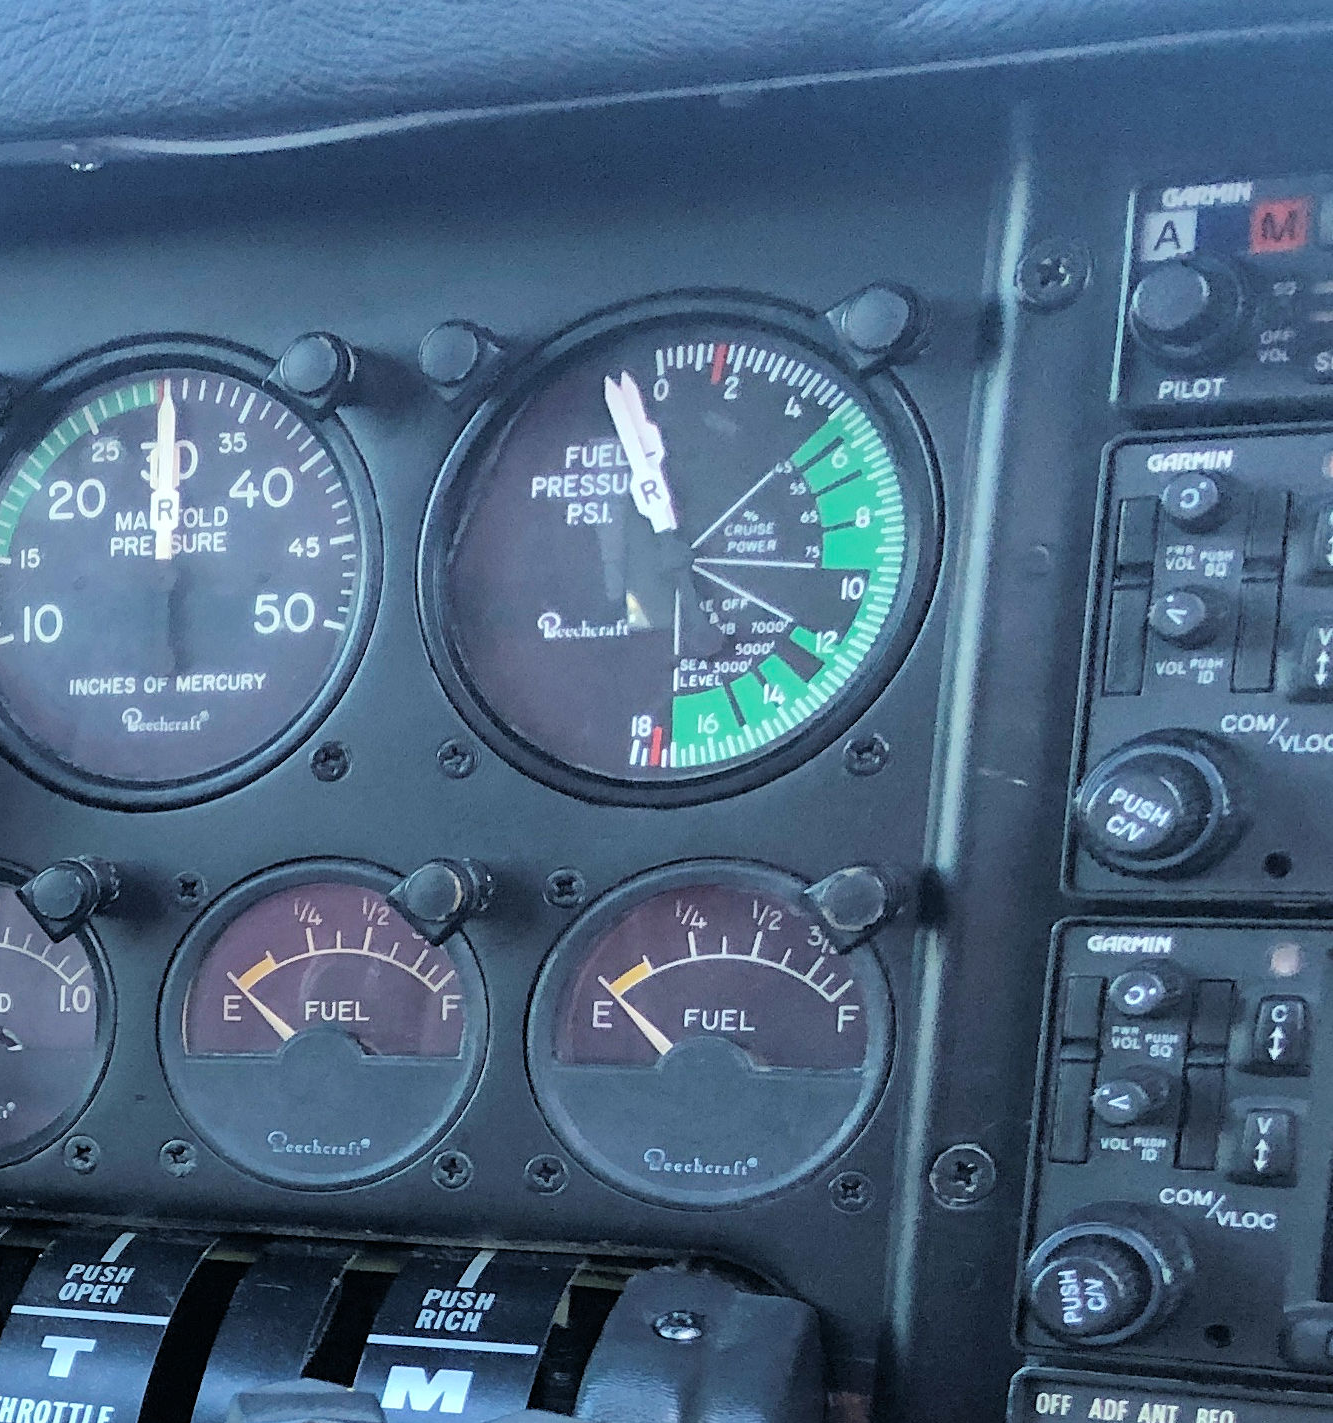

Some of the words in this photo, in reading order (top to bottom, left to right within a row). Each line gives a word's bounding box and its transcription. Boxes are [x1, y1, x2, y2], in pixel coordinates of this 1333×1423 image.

[1162, 181, 1253, 208] GARMIN
[1158, 377, 1226, 399] PILOT
[92, 444, 120, 461] 25
[219, 434, 247, 453] 35
[565, 446, 628, 468] FUEL
[1147, 450, 1233, 472] GARMIN
[49, 479, 106, 519] 20
[229, 467, 294, 508] 40
[115, 506, 228, 531] MAFOLD
[724, 522, 774, 536] CRUISE
[20, 549, 40, 568] 15
[289, 537, 320, 557] 45
[111, 532, 226, 558] PRESURE
[728, 540, 777, 553] POWER
[841, 577, 864, 600] 10
[23, 604, 63, 642] 10
[255, 592, 314, 634] 50
[815, 631, 838, 653] 12
[680, 659, 707, 672] SEA
[69, 678, 136, 696] INCHES
[144, 676, 168, 693] OF
[176, 672, 266, 692] MERCURY
[680, 675, 722, 687] LEVEL
[1108, 788, 1172, 827] PUSH
[293, 899, 324, 924] 1/4
[362, 898, 390, 924] 1/2
[674, 900, 707, 928] 1/4
[752, 900, 782, 931] 1/2
[1087, 935, 1172, 953] GARMIN
[223, 994, 242, 1021] E
[305, 1000, 370, 1021] FUEL
[442, 994, 461, 1020] F
[593, 1001, 613, 1027] E
[683, 1010, 756, 1032] FUEL
[837, 1006, 857, 1032] F
[65, 1263, 136, 1284] PUSH
[58, 1281, 124, 1305] OPEN
[423, 1289, 496, 1311] PUSH
[1059, 1270, 1082, 1324] PUSH
[415, 1309, 483, 1332] RICH
[41, 1336, 97, 1377] T
[381, 1365, 474, 1414] M
[1036, 1392, 1072, 1417] OFF
[1088, 1397, 1129, 1421] ADF
